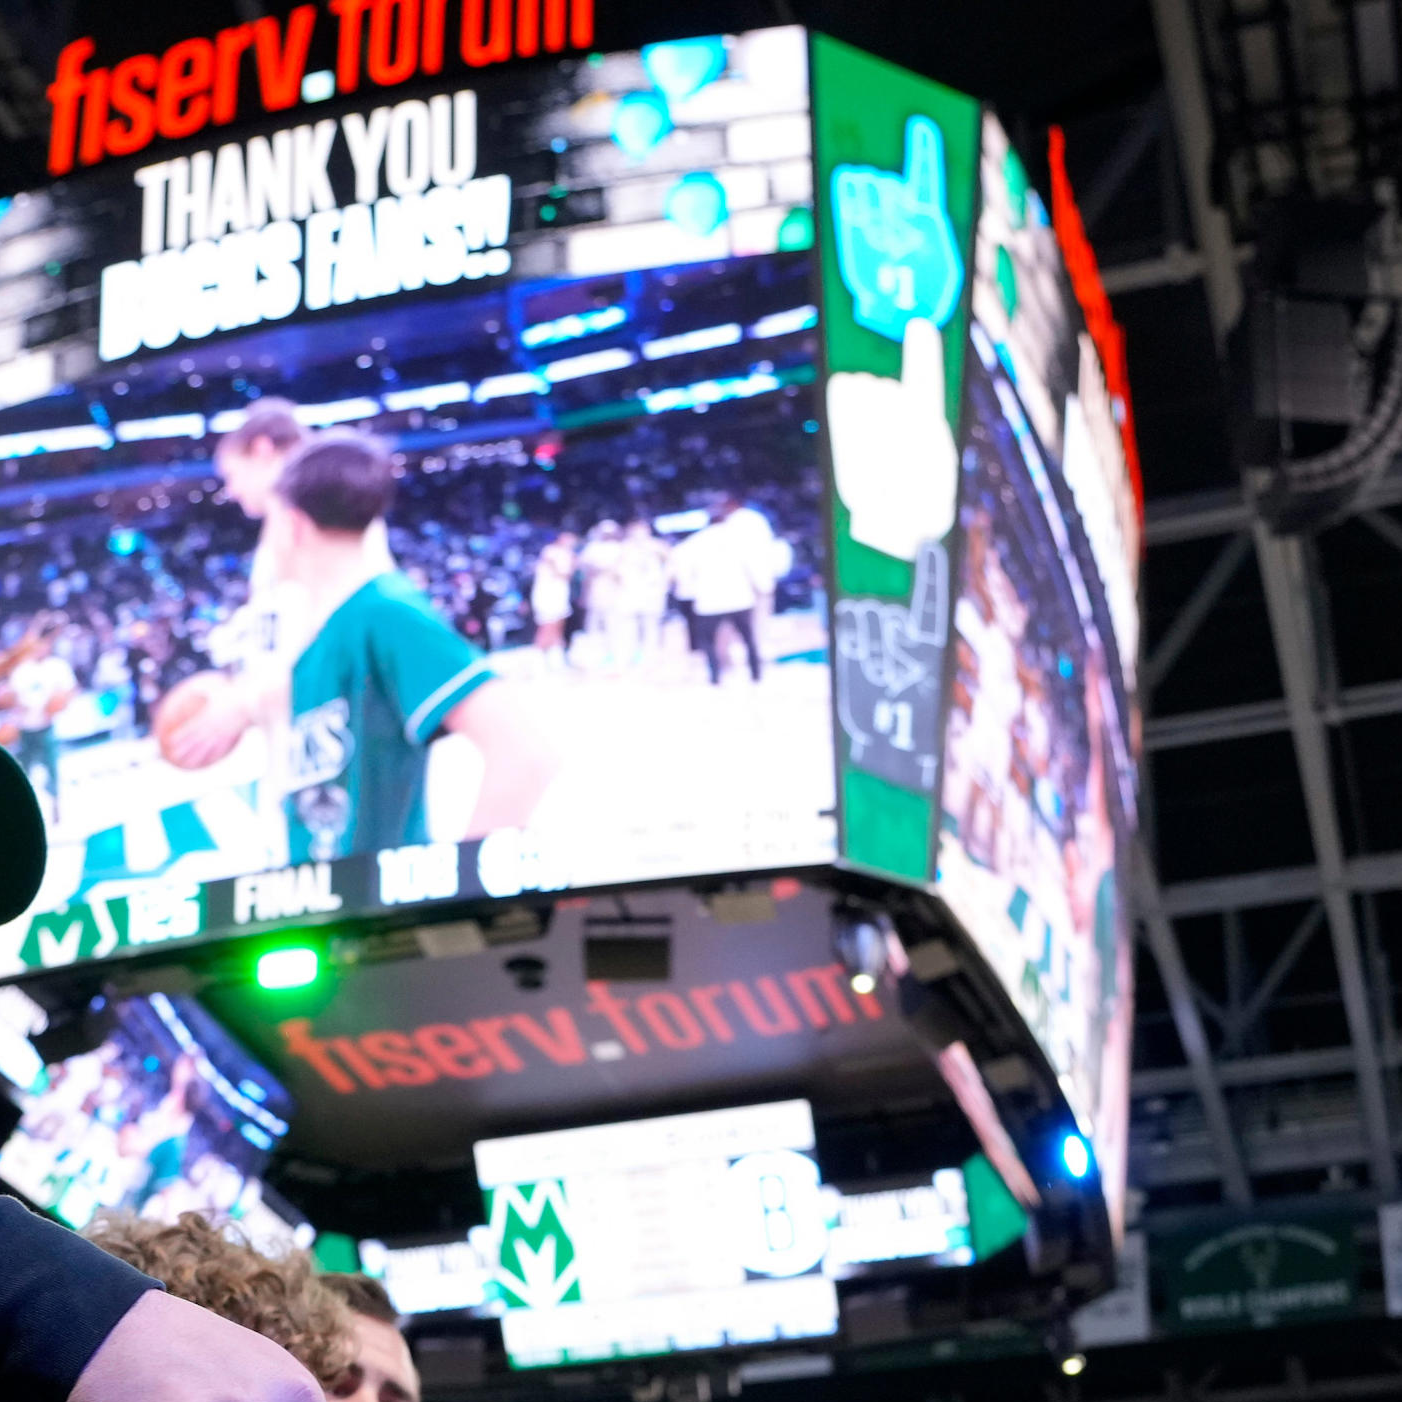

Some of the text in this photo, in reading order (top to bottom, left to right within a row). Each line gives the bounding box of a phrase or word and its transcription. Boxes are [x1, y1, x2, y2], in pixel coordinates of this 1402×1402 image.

[134, 89, 477, 256] THANK YOU
[233, 863, 343, 924] FINAL
[280, 964, 883, 1095] fiserv.forum
